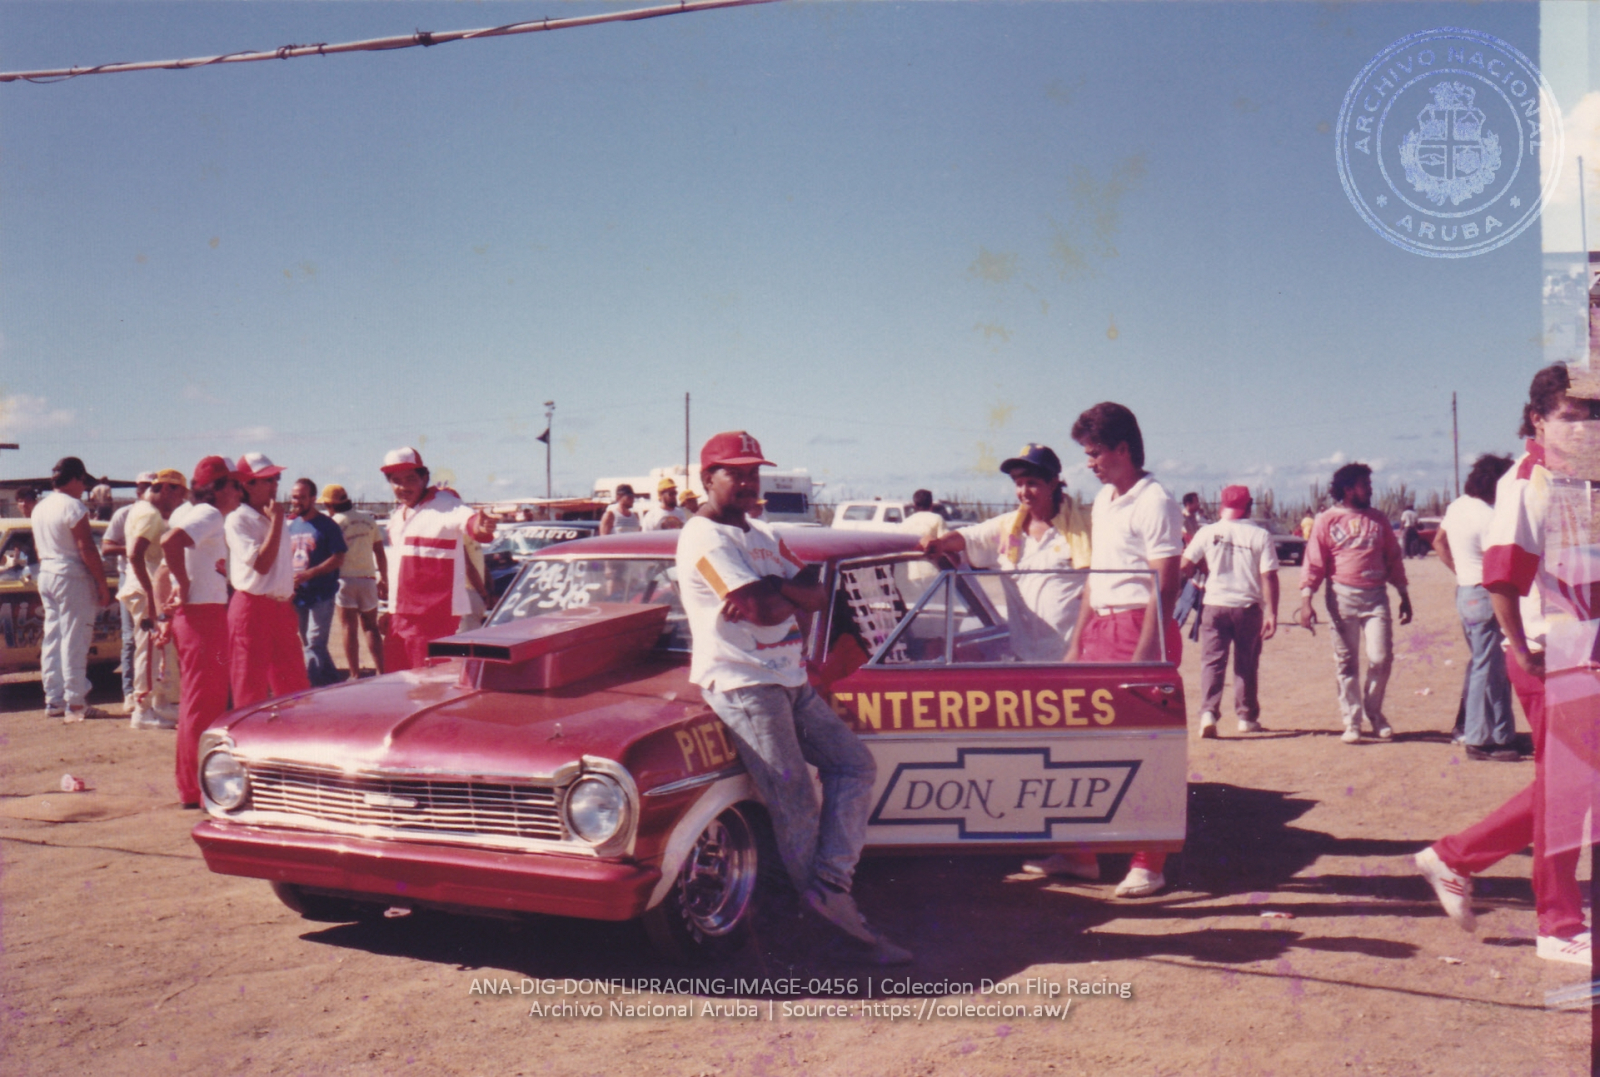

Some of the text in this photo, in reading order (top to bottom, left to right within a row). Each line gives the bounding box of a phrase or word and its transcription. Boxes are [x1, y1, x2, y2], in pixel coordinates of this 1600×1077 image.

[831, 688, 1117, 728] ENTERPRISES
[902, 777, 1112, 819] DON FLIP
